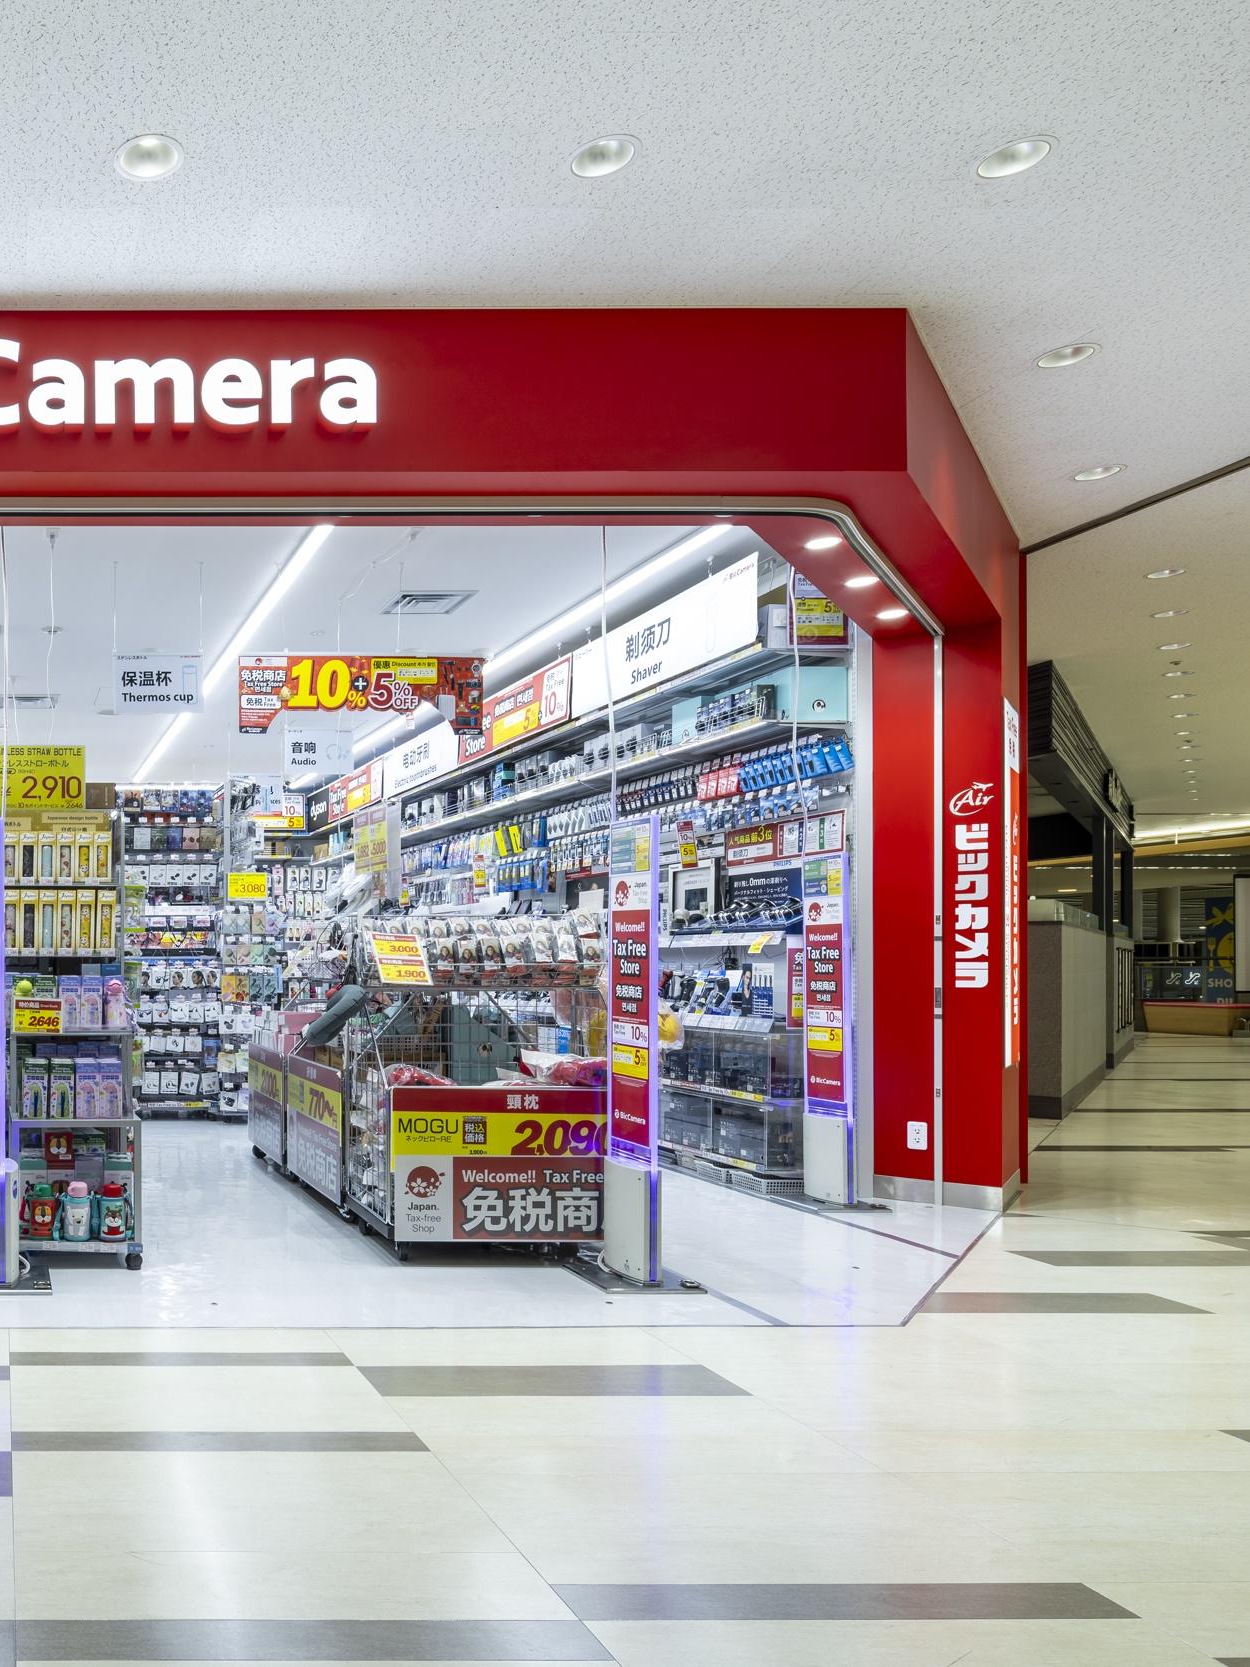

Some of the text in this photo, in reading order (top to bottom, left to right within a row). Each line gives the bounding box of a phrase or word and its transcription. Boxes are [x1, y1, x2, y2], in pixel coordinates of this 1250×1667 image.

[626, 616, 671, 664] 剃须刀
[241, 669, 287, 682] 免税商店
[631, 659, 663, 685] Shaver
[121, 670, 172, 688] 保温杯
[288, 658, 367, 709] 10%
[121, 691, 194, 704] Thermos cup
[246, 697, 263, 706] 免税
[394, 697, 418, 709] OFF
[482, 712, 492, 731] ee
[26, 747, 51, 756] STRAW
[53, 747, 82, 757] BOTTLE
[291, 741, 317, 754] 音响
[465, 735, 486, 757] Store
[403, 740, 430, 769] 电动牙刷
[291, 757, 317, 766] Audio
[21, 775, 83, 802] 2,910
[954, 789, 995, 812] Air
[310, 800, 327, 820] dyson
[773, 859, 793, 868] PHILIPS
[239, 883, 266, 894] 3,080
[954, 822, 989, 990] ビックカメラ
[614, 921, 646, 933] Welcome!!
[808, 932, 838, 942] Welcome!!
[389, 945, 419, 954] 3,000
[612, 939, 647, 957] Tax Free
[806, 946, 840, 960] Tax Free
[620, 958, 640, 976] Store
[814, 959, 833, 973] Store
[396, 969, 427, 979] 1,900
[810, 980, 836, 992] 免税商店
[1207, 978, 1233, 988] SHO
[615, 984, 643, 999] 免税商店
[28, 1015, 60, 1028] 2,646
[815, 1076, 841, 1087] BicCamera
[620, 1111, 646, 1125] BicCamera
[398, 1117, 459, 1135] MOGU
[464, 1123, 485, 1133] 税込
[464, 1133, 485, 1143] 価格
[461, 1169, 605, 1184] Welcome!! Tax Free
[462, 1186, 604, 1233] 免税商
[405, 1213, 442, 1223] Tax-free
[412, 1223, 435, 1234] Shop
